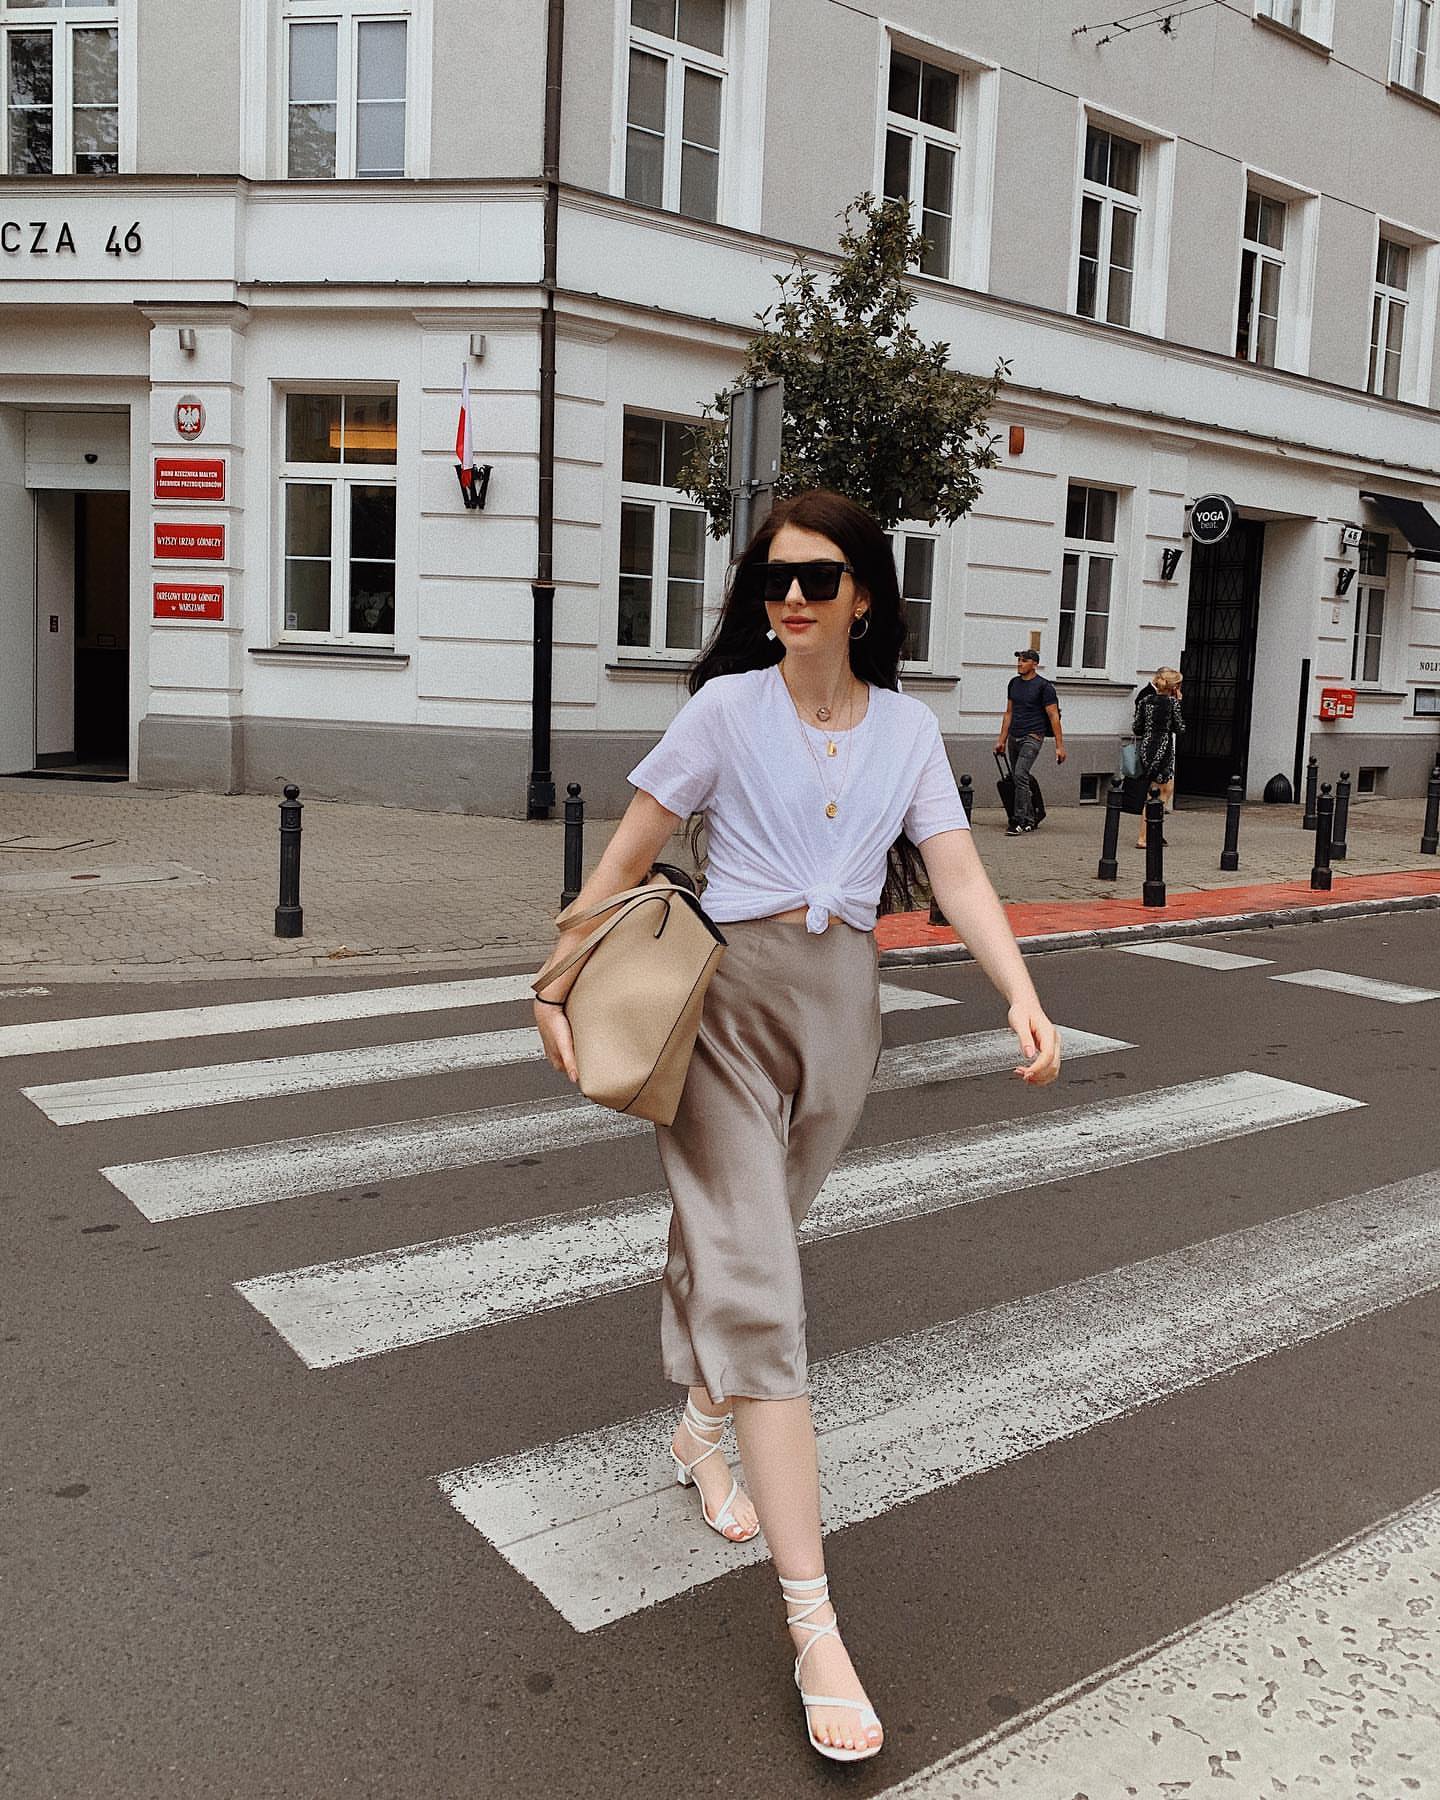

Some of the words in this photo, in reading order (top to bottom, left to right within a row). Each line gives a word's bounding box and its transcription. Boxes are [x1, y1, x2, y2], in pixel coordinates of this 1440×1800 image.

[1, 221, 76, 254] CZA
[104, 221, 142, 256] 46
[1196, 510, 1225, 522] YOGA
[1419, 661, 1440, 672] NOLI
